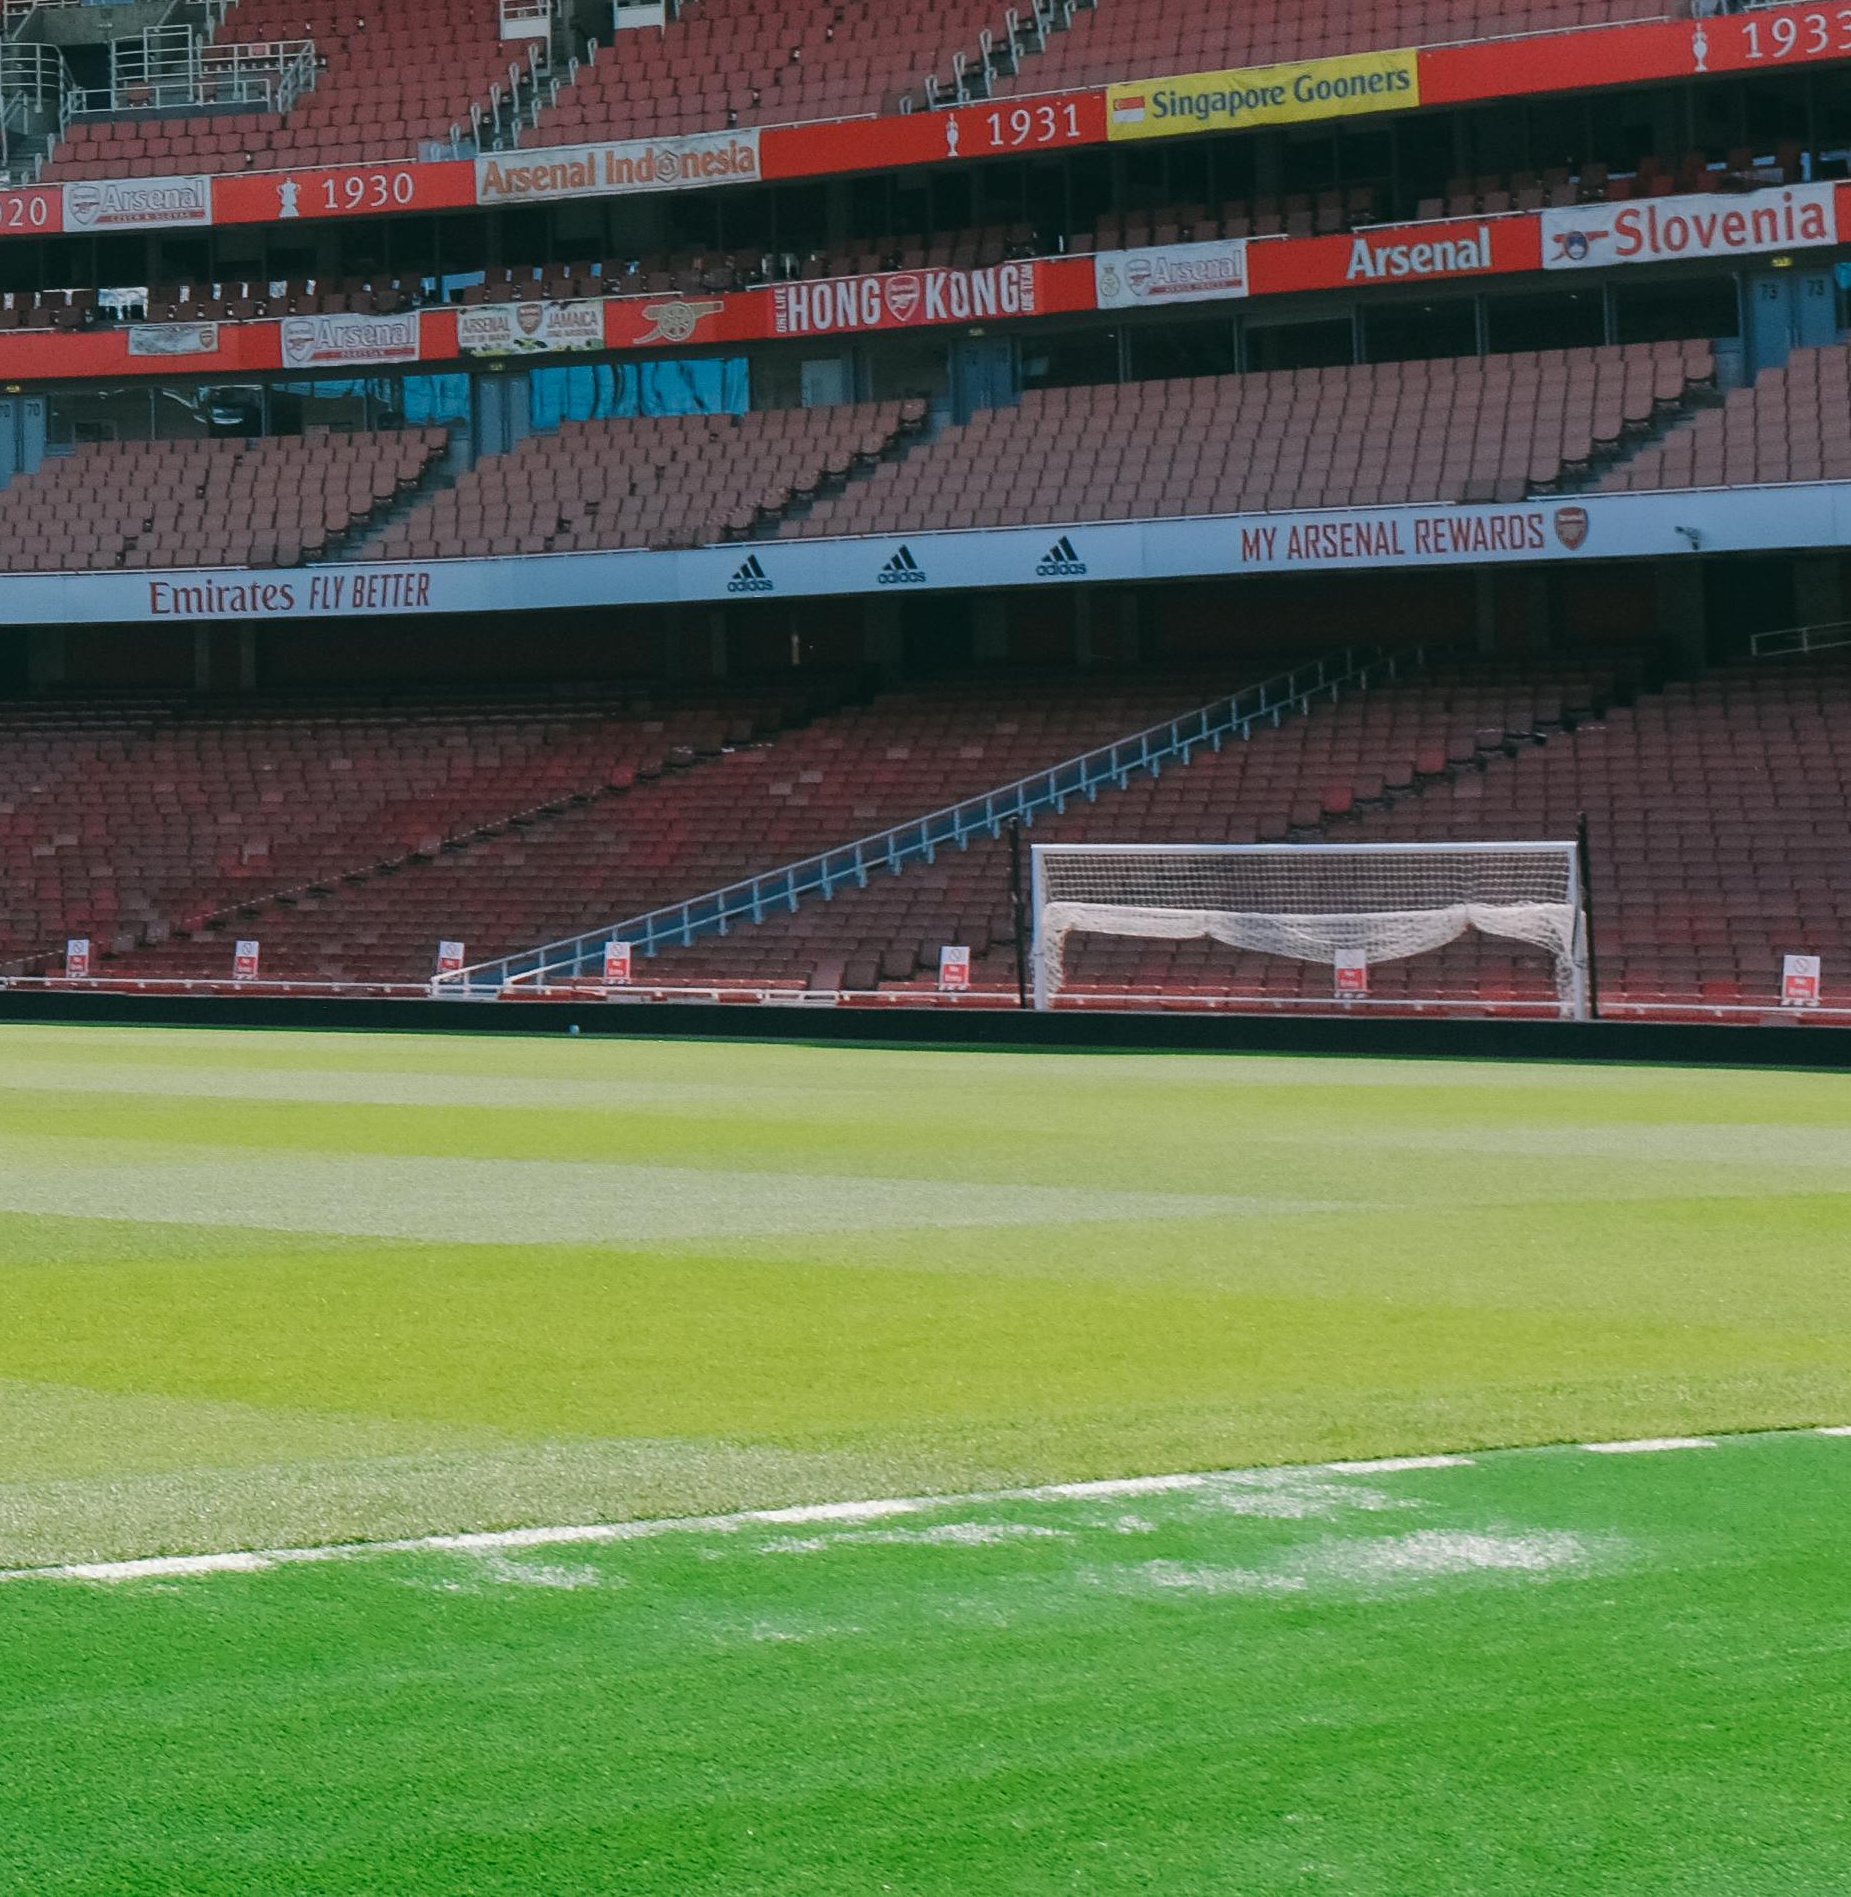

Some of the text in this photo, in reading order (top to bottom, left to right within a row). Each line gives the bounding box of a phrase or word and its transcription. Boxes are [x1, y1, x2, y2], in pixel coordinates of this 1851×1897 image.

[1741, 10, 1851, 59] 1933
[1151, 65, 1411, 121] Singapore Gooners
[987, 107, 1082, 147] 1931
[323, 173, 414, 209] 1930
[482, 151, 596, 198] Arsenal
[100, 181, 203, 213] Arsenal
[1613, 192, 1827, 258] Slovenia
[1153, 250, 1242, 284] Arsenal
[1346, 226, 1492, 279] Arsenal
[774, 287, 787, 312] LIFE
[788, 265, 1020, 332] HONG KONG
[316, 315, 416, 349] Arsenal
[1241, 512, 1546, 562] MY ARSENAL REWARDS
[727, 578, 774, 592] adidas
[878, 569, 926, 584] adidas
[1036, 561, 1087, 576] adidas
[149, 571, 431, 615] Emirates FLY BETTER
